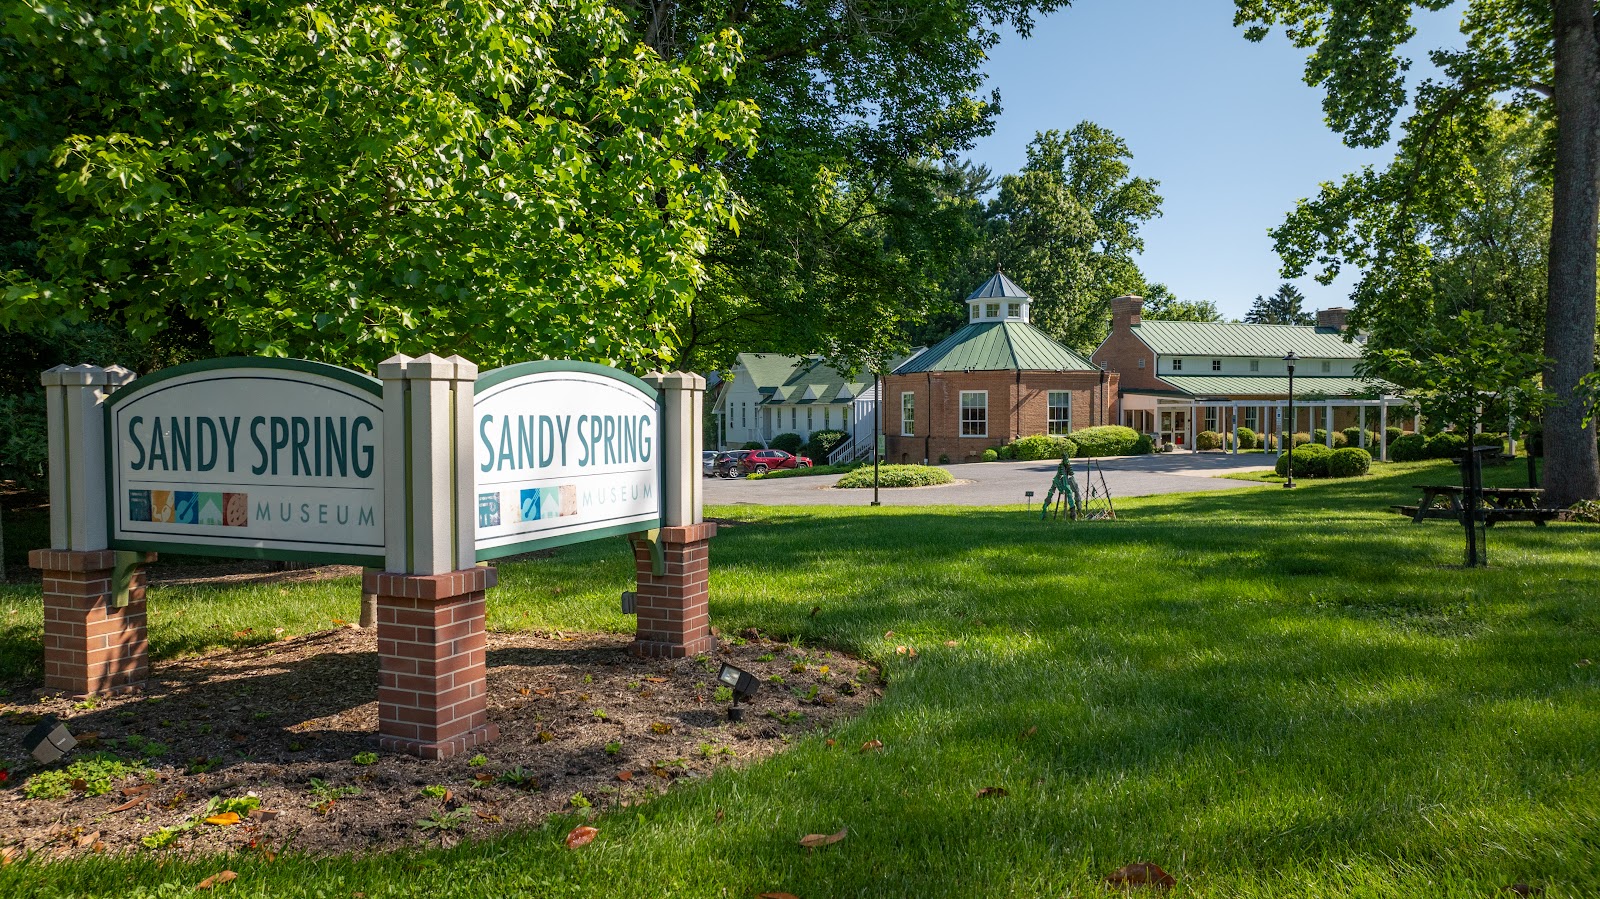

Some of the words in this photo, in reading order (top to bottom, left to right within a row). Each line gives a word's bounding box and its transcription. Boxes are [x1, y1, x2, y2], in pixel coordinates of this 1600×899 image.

[129, 416, 240, 472] SANDY
[250, 416, 374, 478] SPRING
[480, 414, 571, 472] SANDY
[578, 414, 651, 467] SPRING
[256, 502, 374, 526] MUSEUM
[583, 485, 652, 507] MUSEUM
